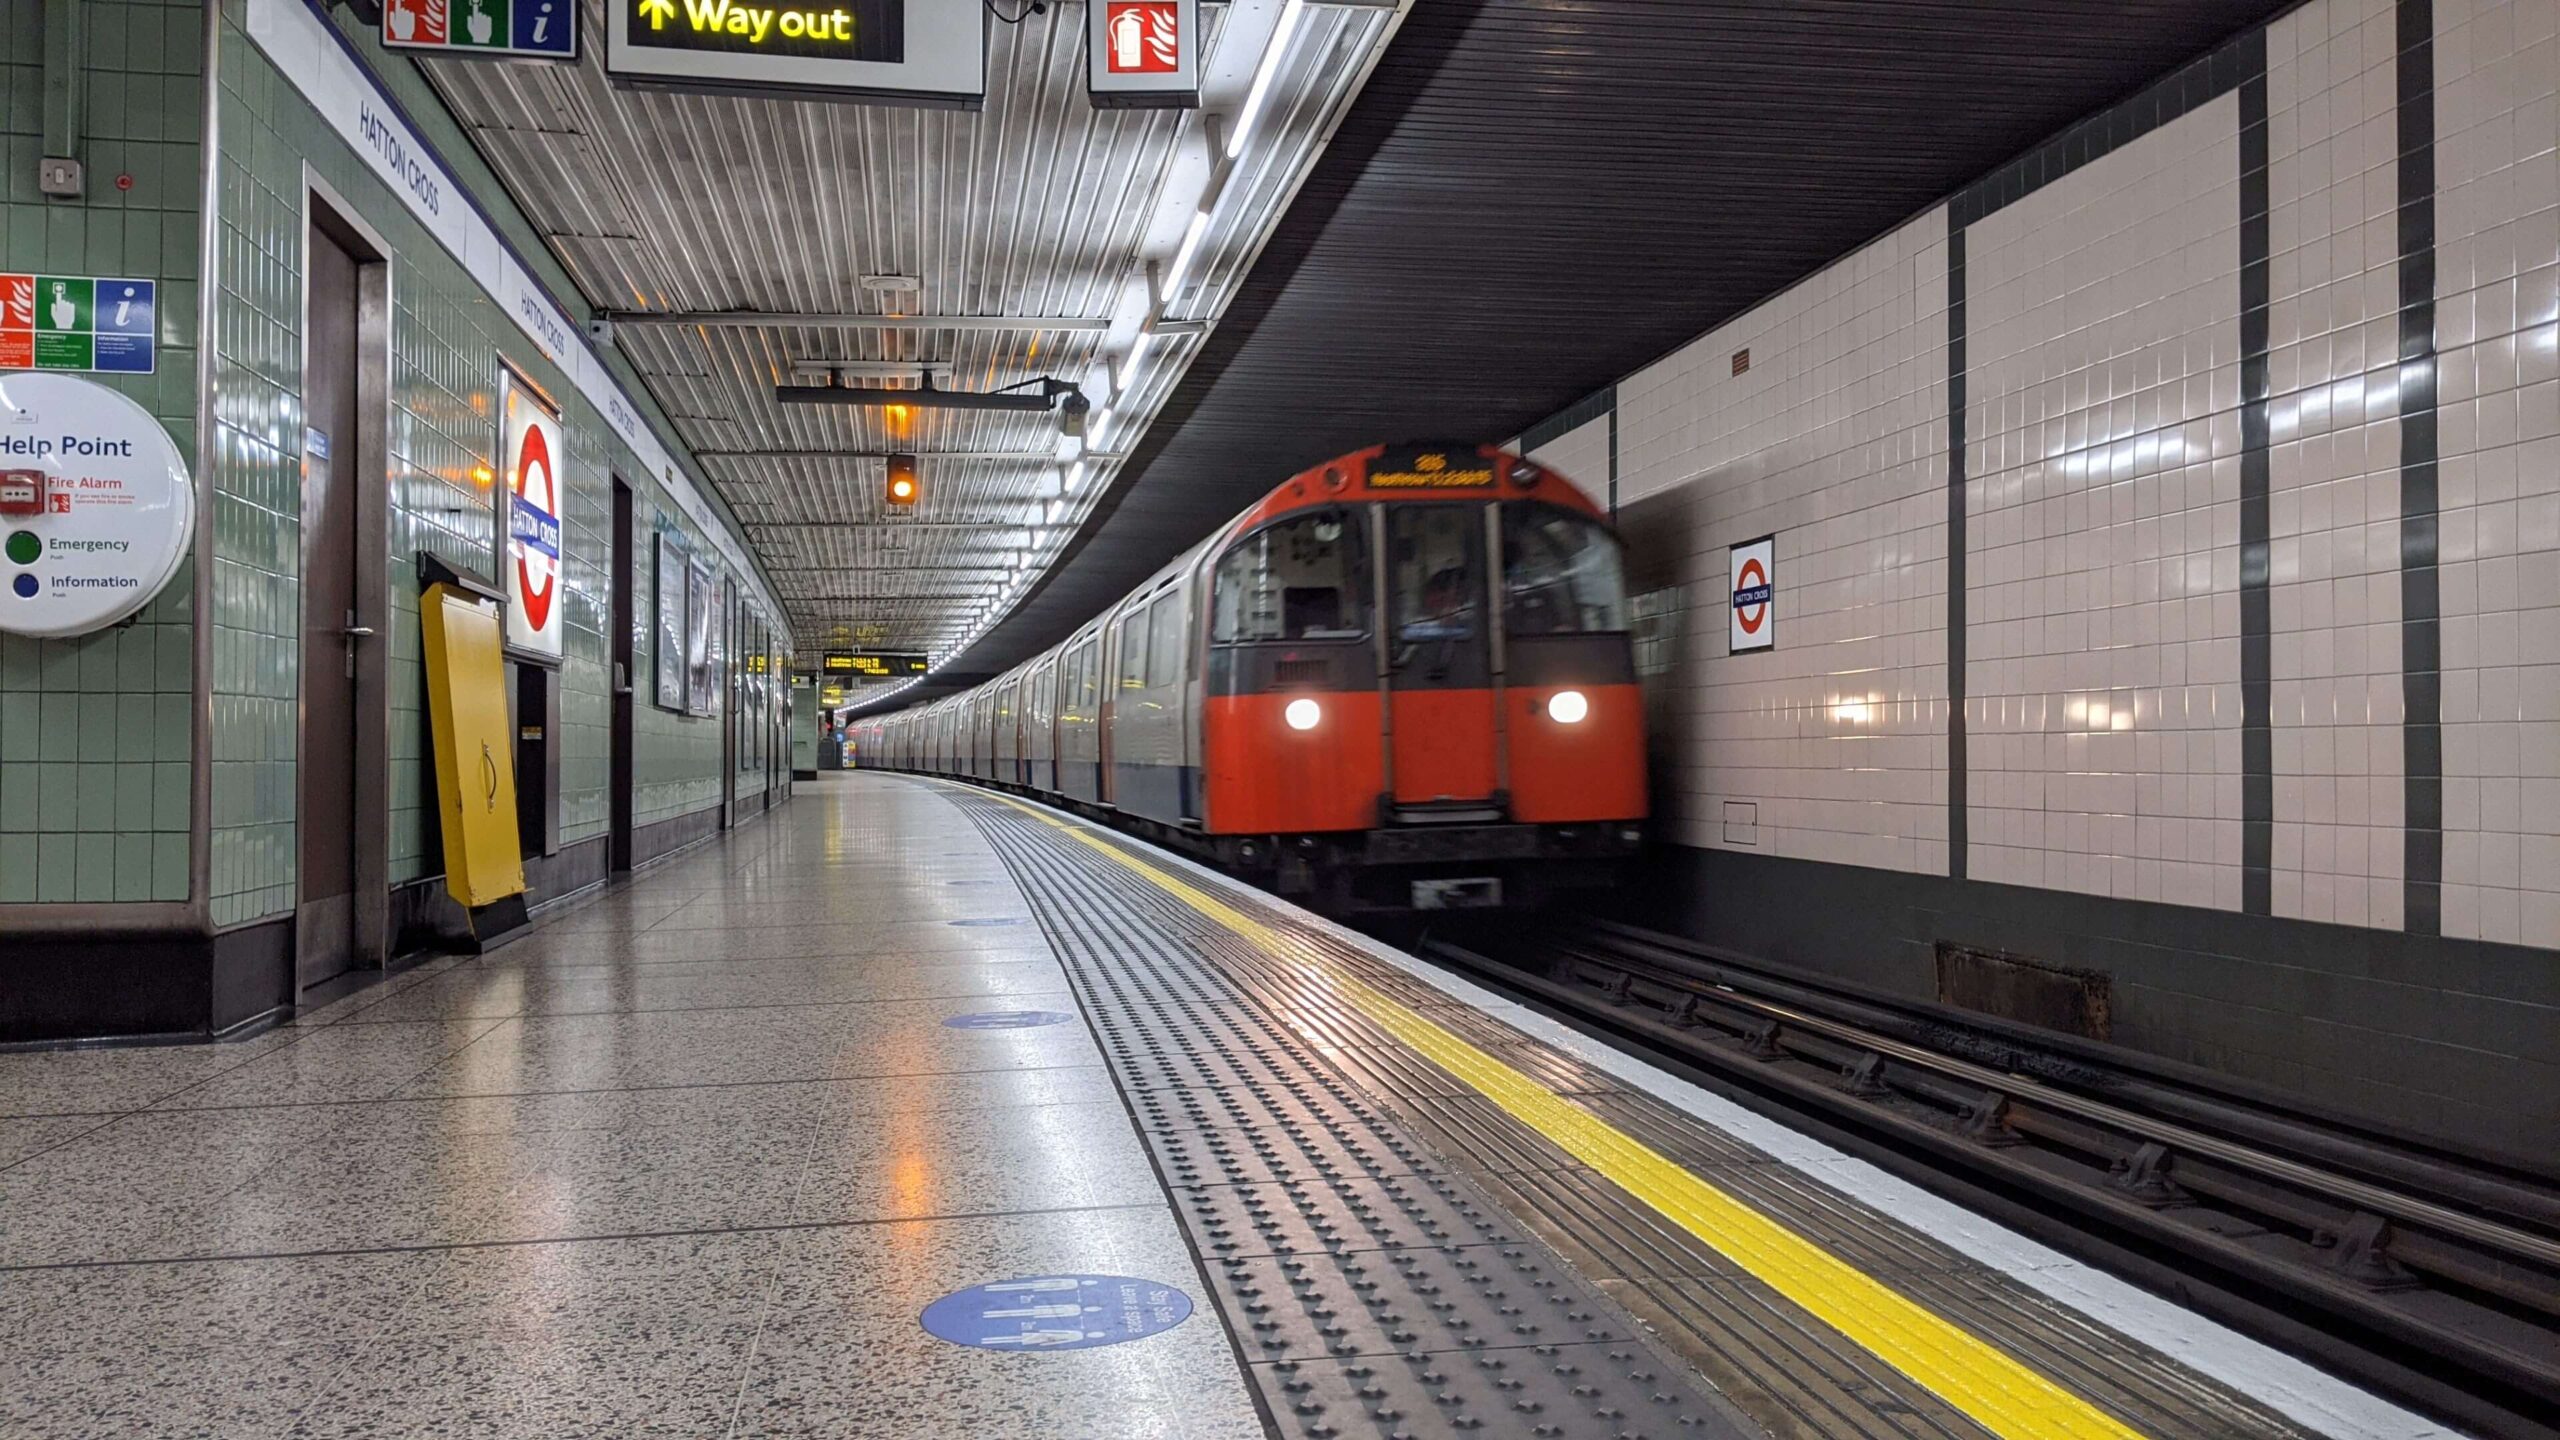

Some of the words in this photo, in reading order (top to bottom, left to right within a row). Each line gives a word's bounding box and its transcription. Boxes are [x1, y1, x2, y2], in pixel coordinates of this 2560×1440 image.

[684, 0, 773, 43] Way
[779, 9, 851, 41] out
[360, 100, 406, 180] HATTON
[408, 158, 439, 216] CROSS
[521, 288, 547, 337] HATTON
[547, 320, 565, 357] CROSS
[0, 435, 52, 460] Help
[62, 436, 132, 458] Point
[48, 476, 75, 489] Fire
[79, 477, 122, 489] Alarm
[513, 503, 538, 539] HATTON
[540, 520, 558, 550] CROSS
[49, 538, 129, 553] Emergency
[51, 576, 138, 588] Information
[1735, 593, 1753, 604] HATTON
[1754, 589, 1768, 600] CROSS
[1120, 1284, 1138, 1305] Leave
[1147, 1290, 1169, 1305] Stay
[1120, 1311, 1143, 1333] space
[1153, 1306, 1175, 1323] Safe
